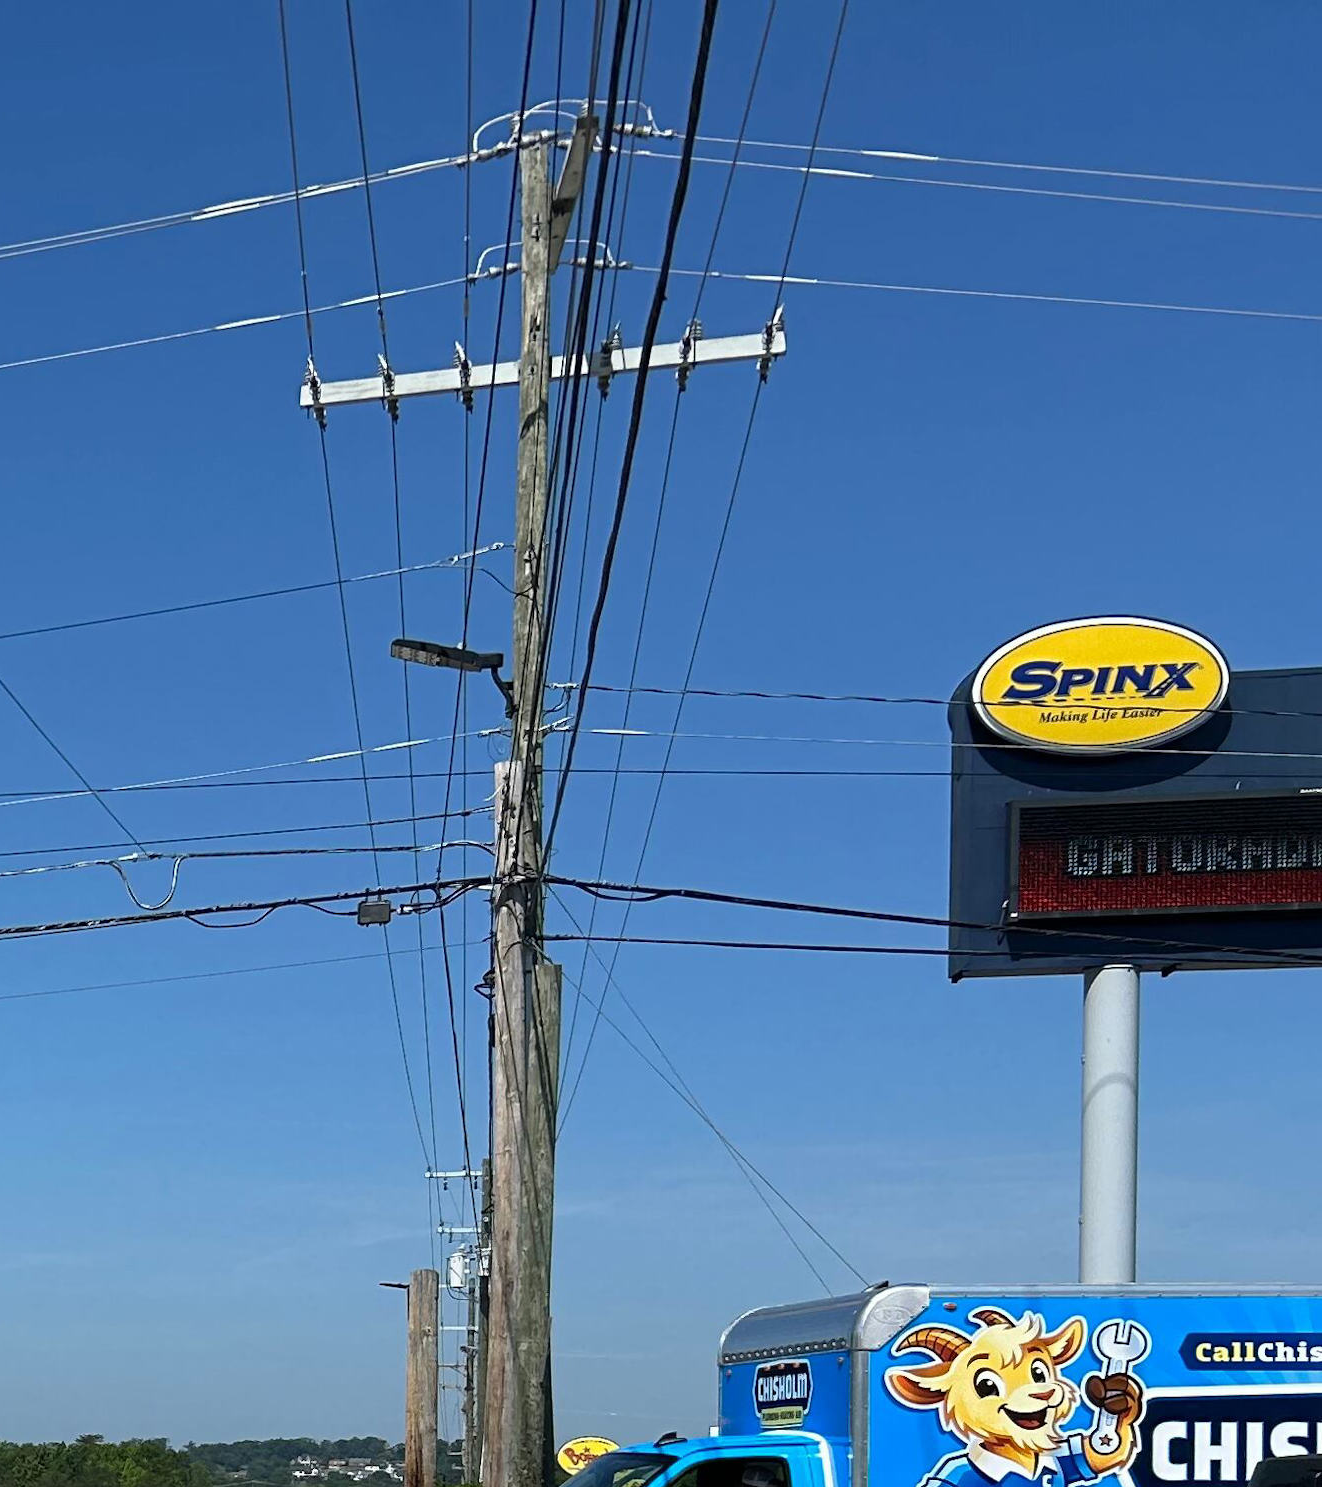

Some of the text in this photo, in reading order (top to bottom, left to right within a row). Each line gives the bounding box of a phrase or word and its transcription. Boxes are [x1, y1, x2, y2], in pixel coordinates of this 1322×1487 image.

[1002, 660, 1199, 698] SPINX
[1039, 708, 1163, 723] Making Life Easier
[758, 1373, 807, 1402] CHISHOLM
[1152, 1421, 1322, 1481] CHIS
